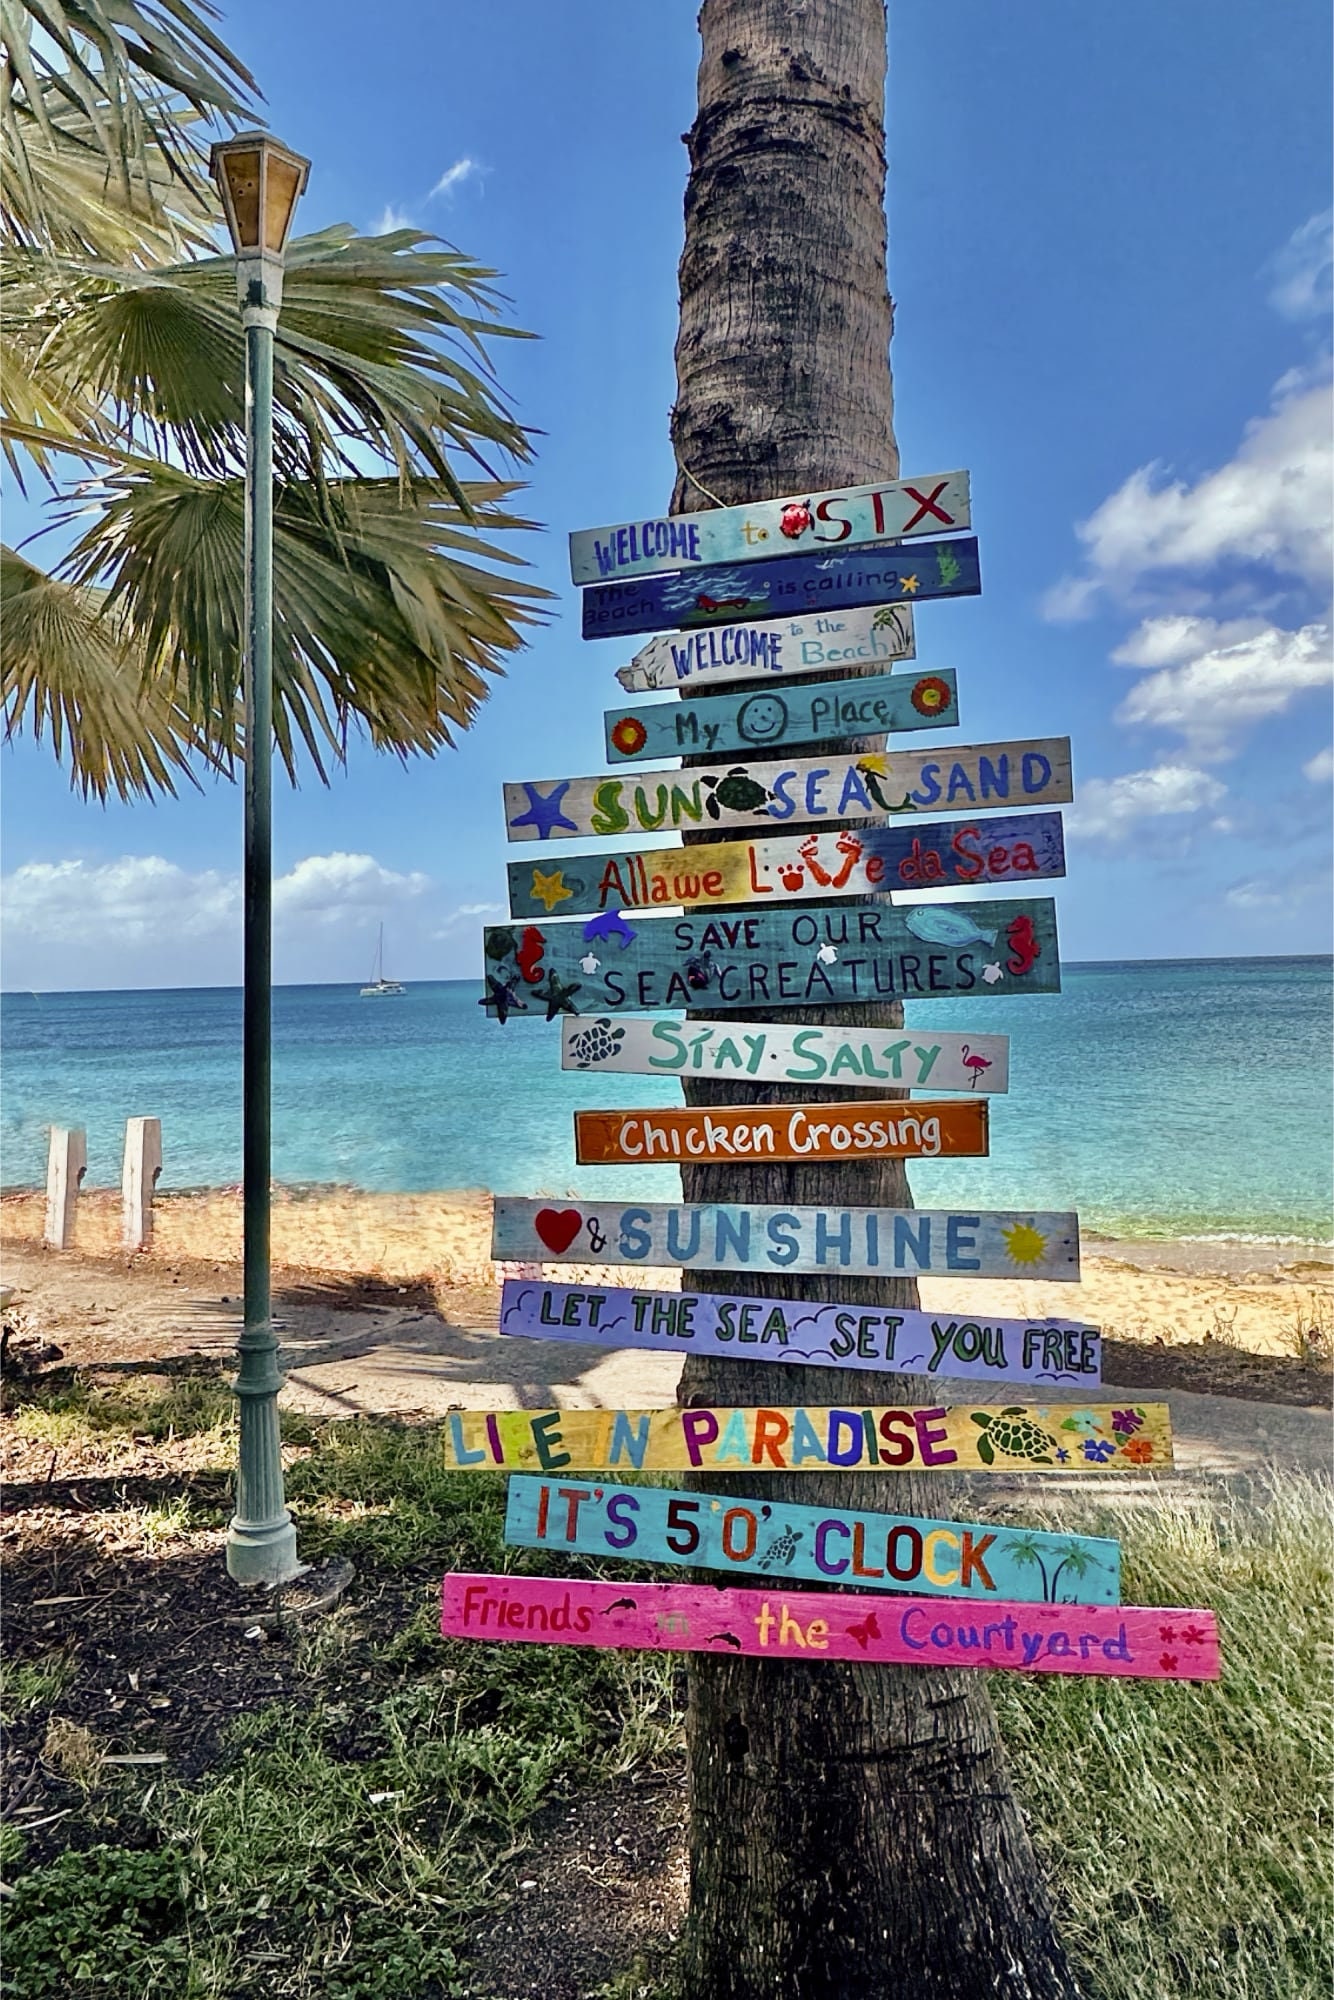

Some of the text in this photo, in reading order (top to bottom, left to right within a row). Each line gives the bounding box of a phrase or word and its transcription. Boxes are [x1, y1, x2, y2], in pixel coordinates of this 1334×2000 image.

[593, 521, 702, 575] WELCOME
[814, 482, 955, 542] STX
[585, 570, 898, 625] Beach is calling
[594, 584, 640, 606] The
[671, 628, 783, 680] WELCOME
[787, 619, 847, 637] to the
[801, 629, 890, 665] Beach
[675, 695, 890, 750] My Place
[591, 752, 1052, 834] SUN SEA SAND
[598, 855, 725, 908] Allawe
[899, 838, 947, 881] da
[952, 827, 1040, 879] Sea
[674, 912, 883, 952] SAVE OUR
[604, 953, 977, 1006] SEA CREATURES
[648, 1020, 942, 1084] STAY SALTY
[619, 1111, 942, 1157] Chicken Crossing
[618, 1208, 982, 1271] SUNSHINE
[541, 1291, 1101, 1374] LET THE SEA SET YOU FREE
[450, 1407, 958, 1470] LIFE IN PARADISE
[536, 1486, 640, 1550] IT'S
[666, 1498, 701, 1555] 5
[815, 1518, 998, 1591] CLOCK
[463, 1586, 593, 1633] Friends
[754, 1602, 829, 1650] the
[900, 1606, 1135, 1666] Courtyard
